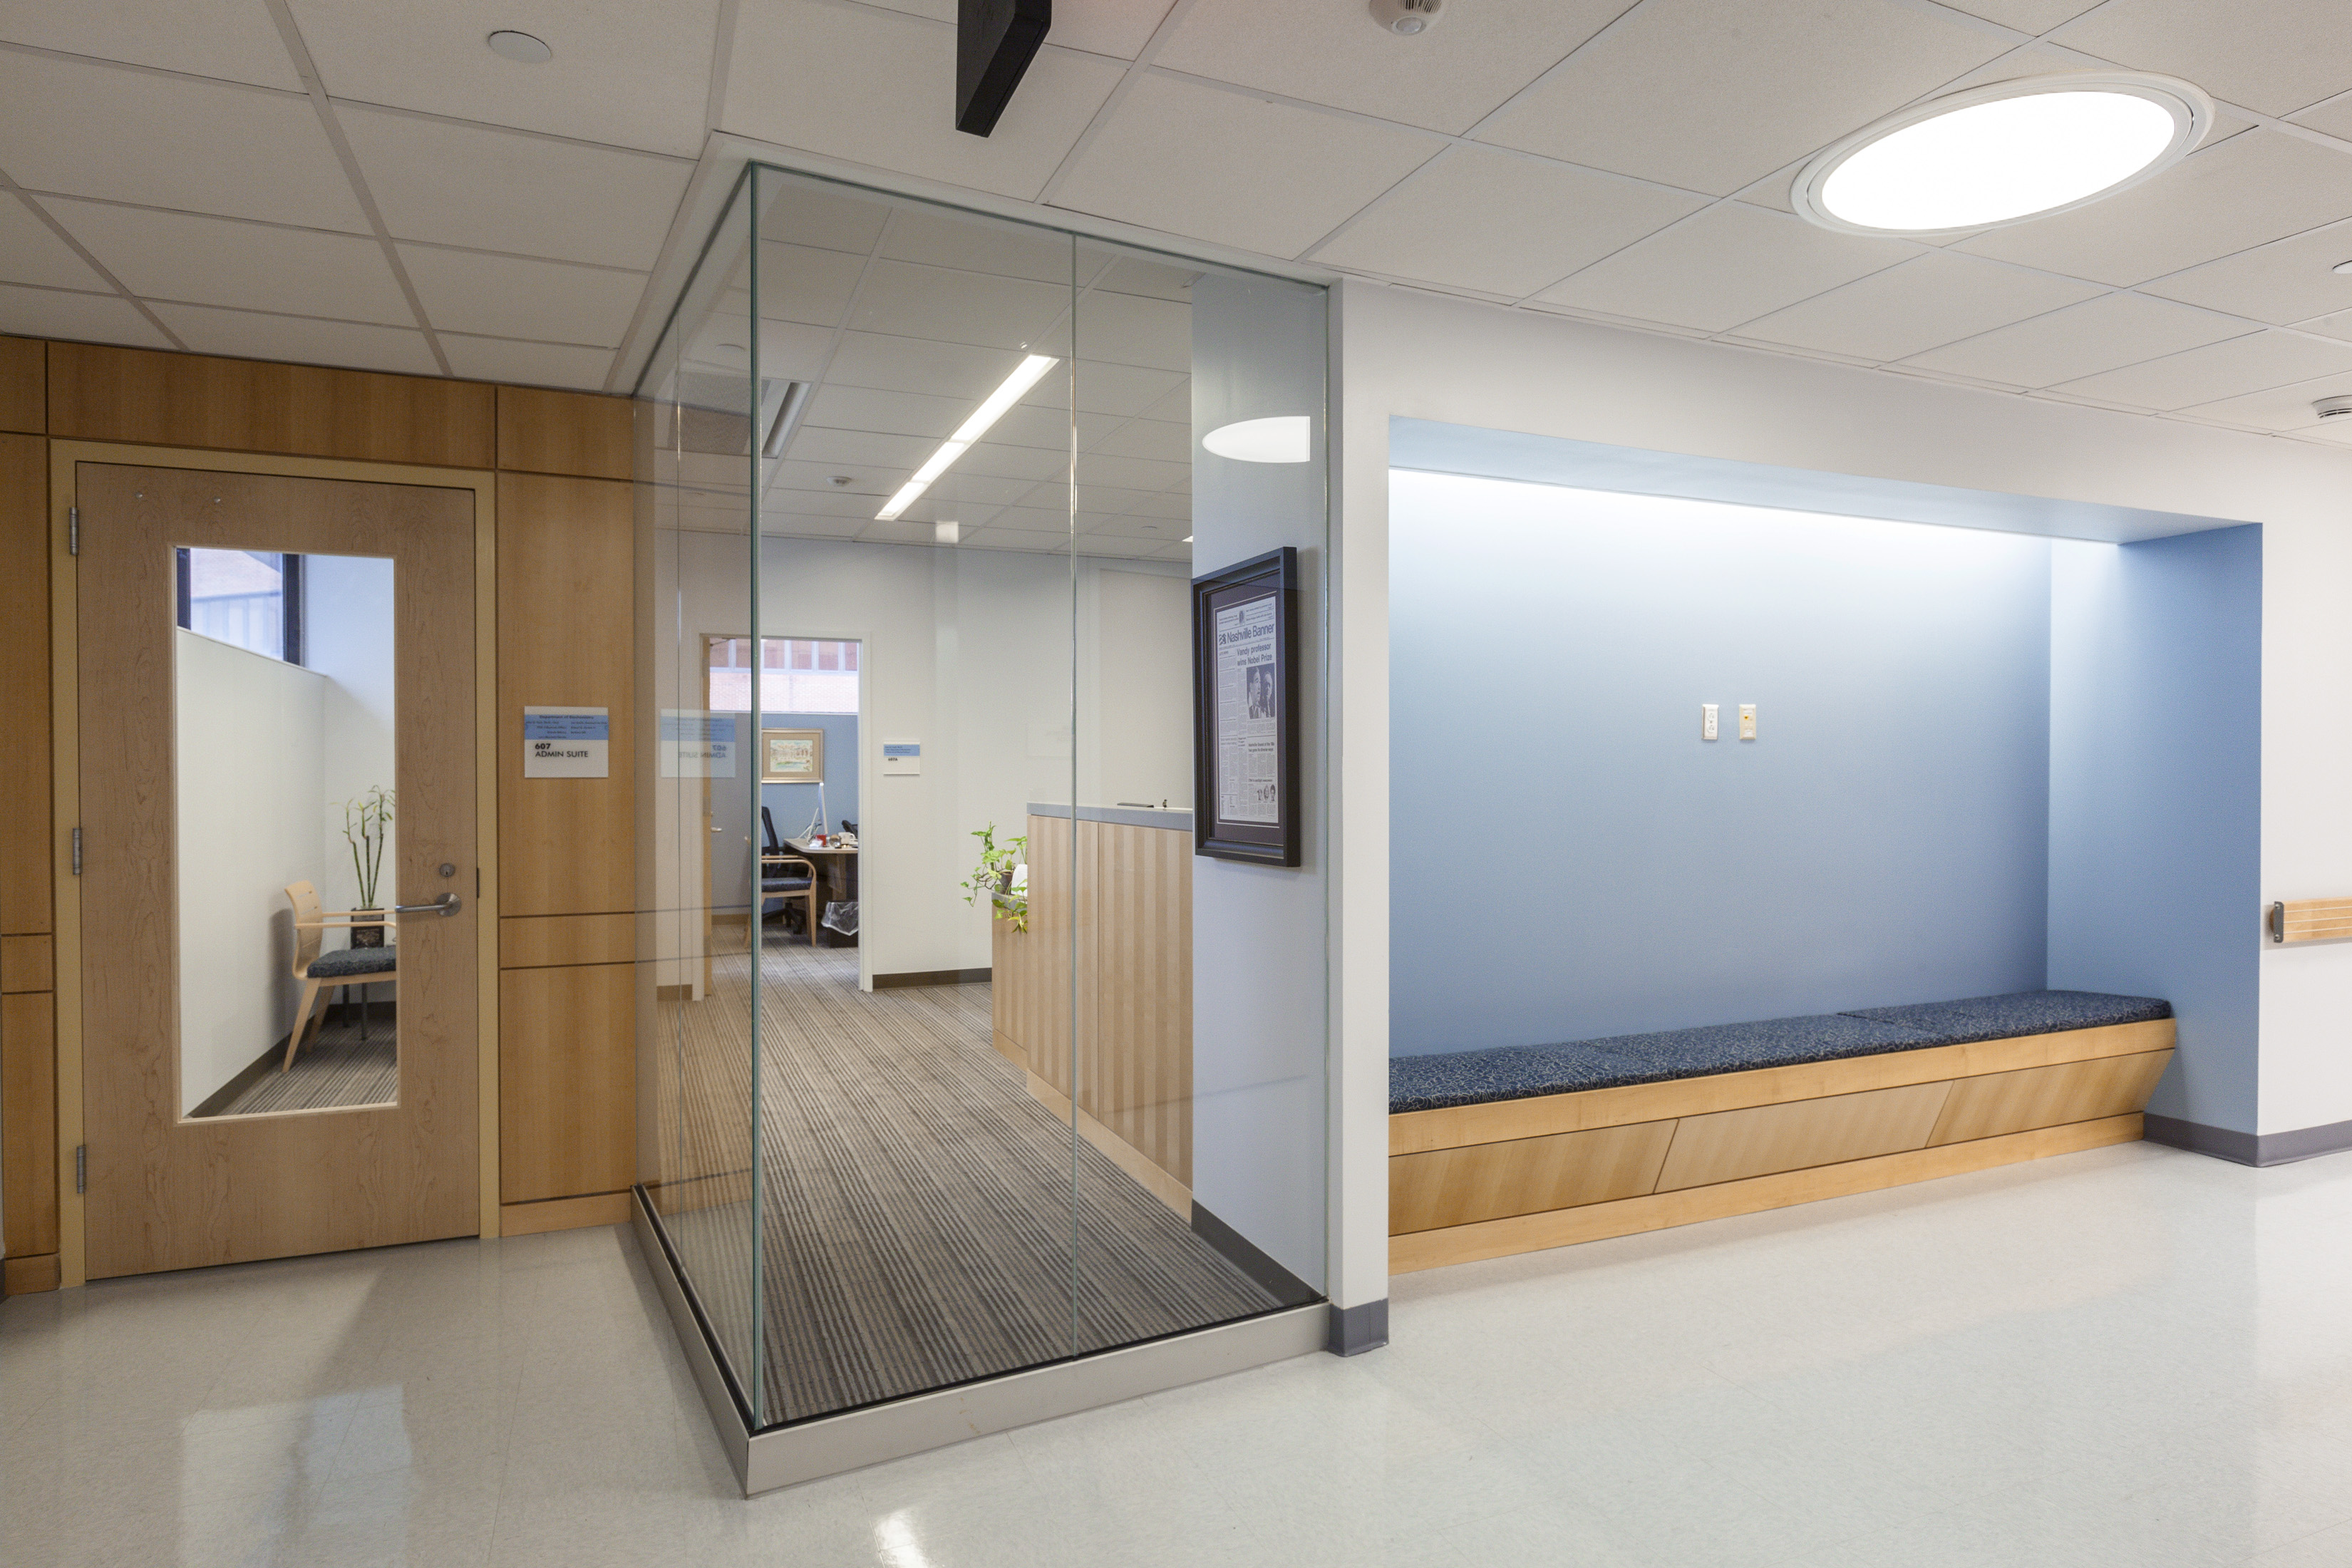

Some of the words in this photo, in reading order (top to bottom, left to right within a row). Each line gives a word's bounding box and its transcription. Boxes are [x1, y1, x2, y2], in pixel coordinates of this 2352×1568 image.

[1227, 627, 1252, 644] Nashville
[1252, 624, 1274, 637] Banner
[1237, 647, 1249, 656] Vandy
[1251, 644, 1272, 655] professor
[1247, 655, 1260, 664] Nobel
[1261, 654, 1272, 662] Prize
